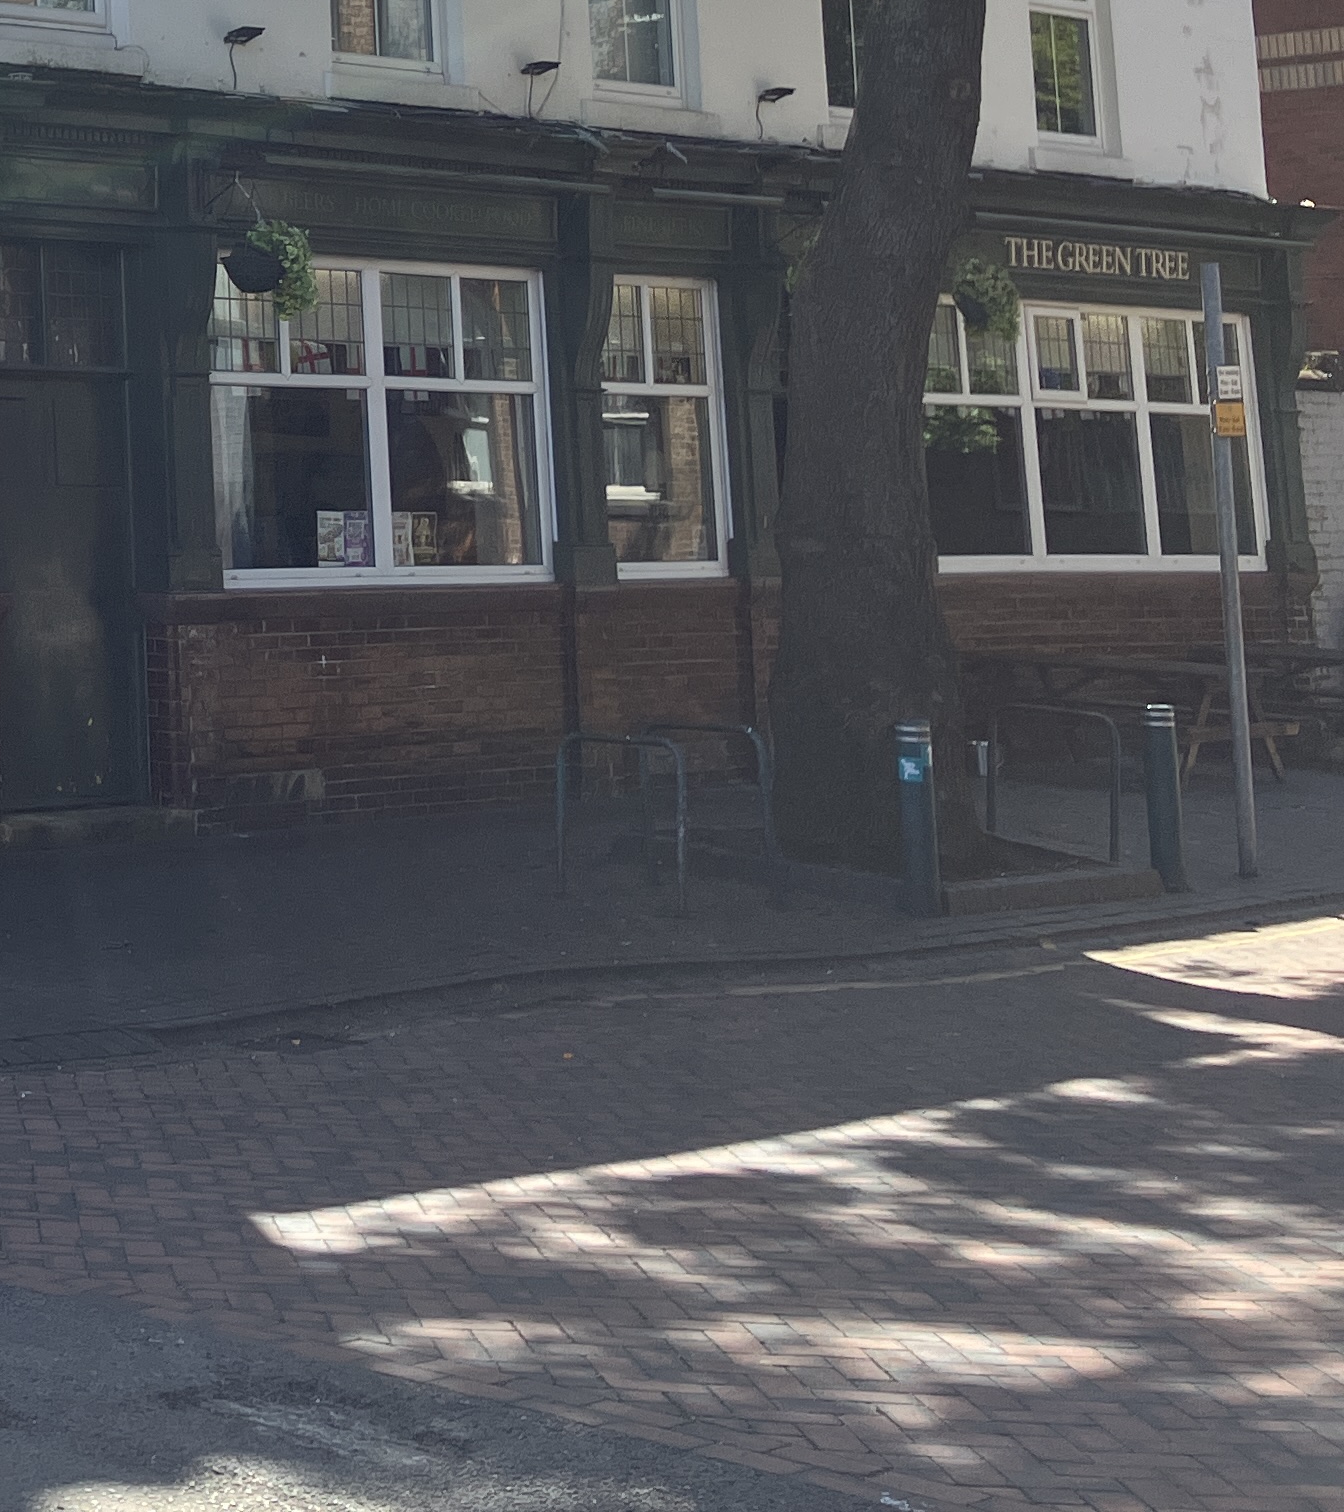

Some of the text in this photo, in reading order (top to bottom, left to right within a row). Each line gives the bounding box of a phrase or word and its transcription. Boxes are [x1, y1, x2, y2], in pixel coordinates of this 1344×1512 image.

[1004, 236, 1190, 281] THE GREEN TREE
